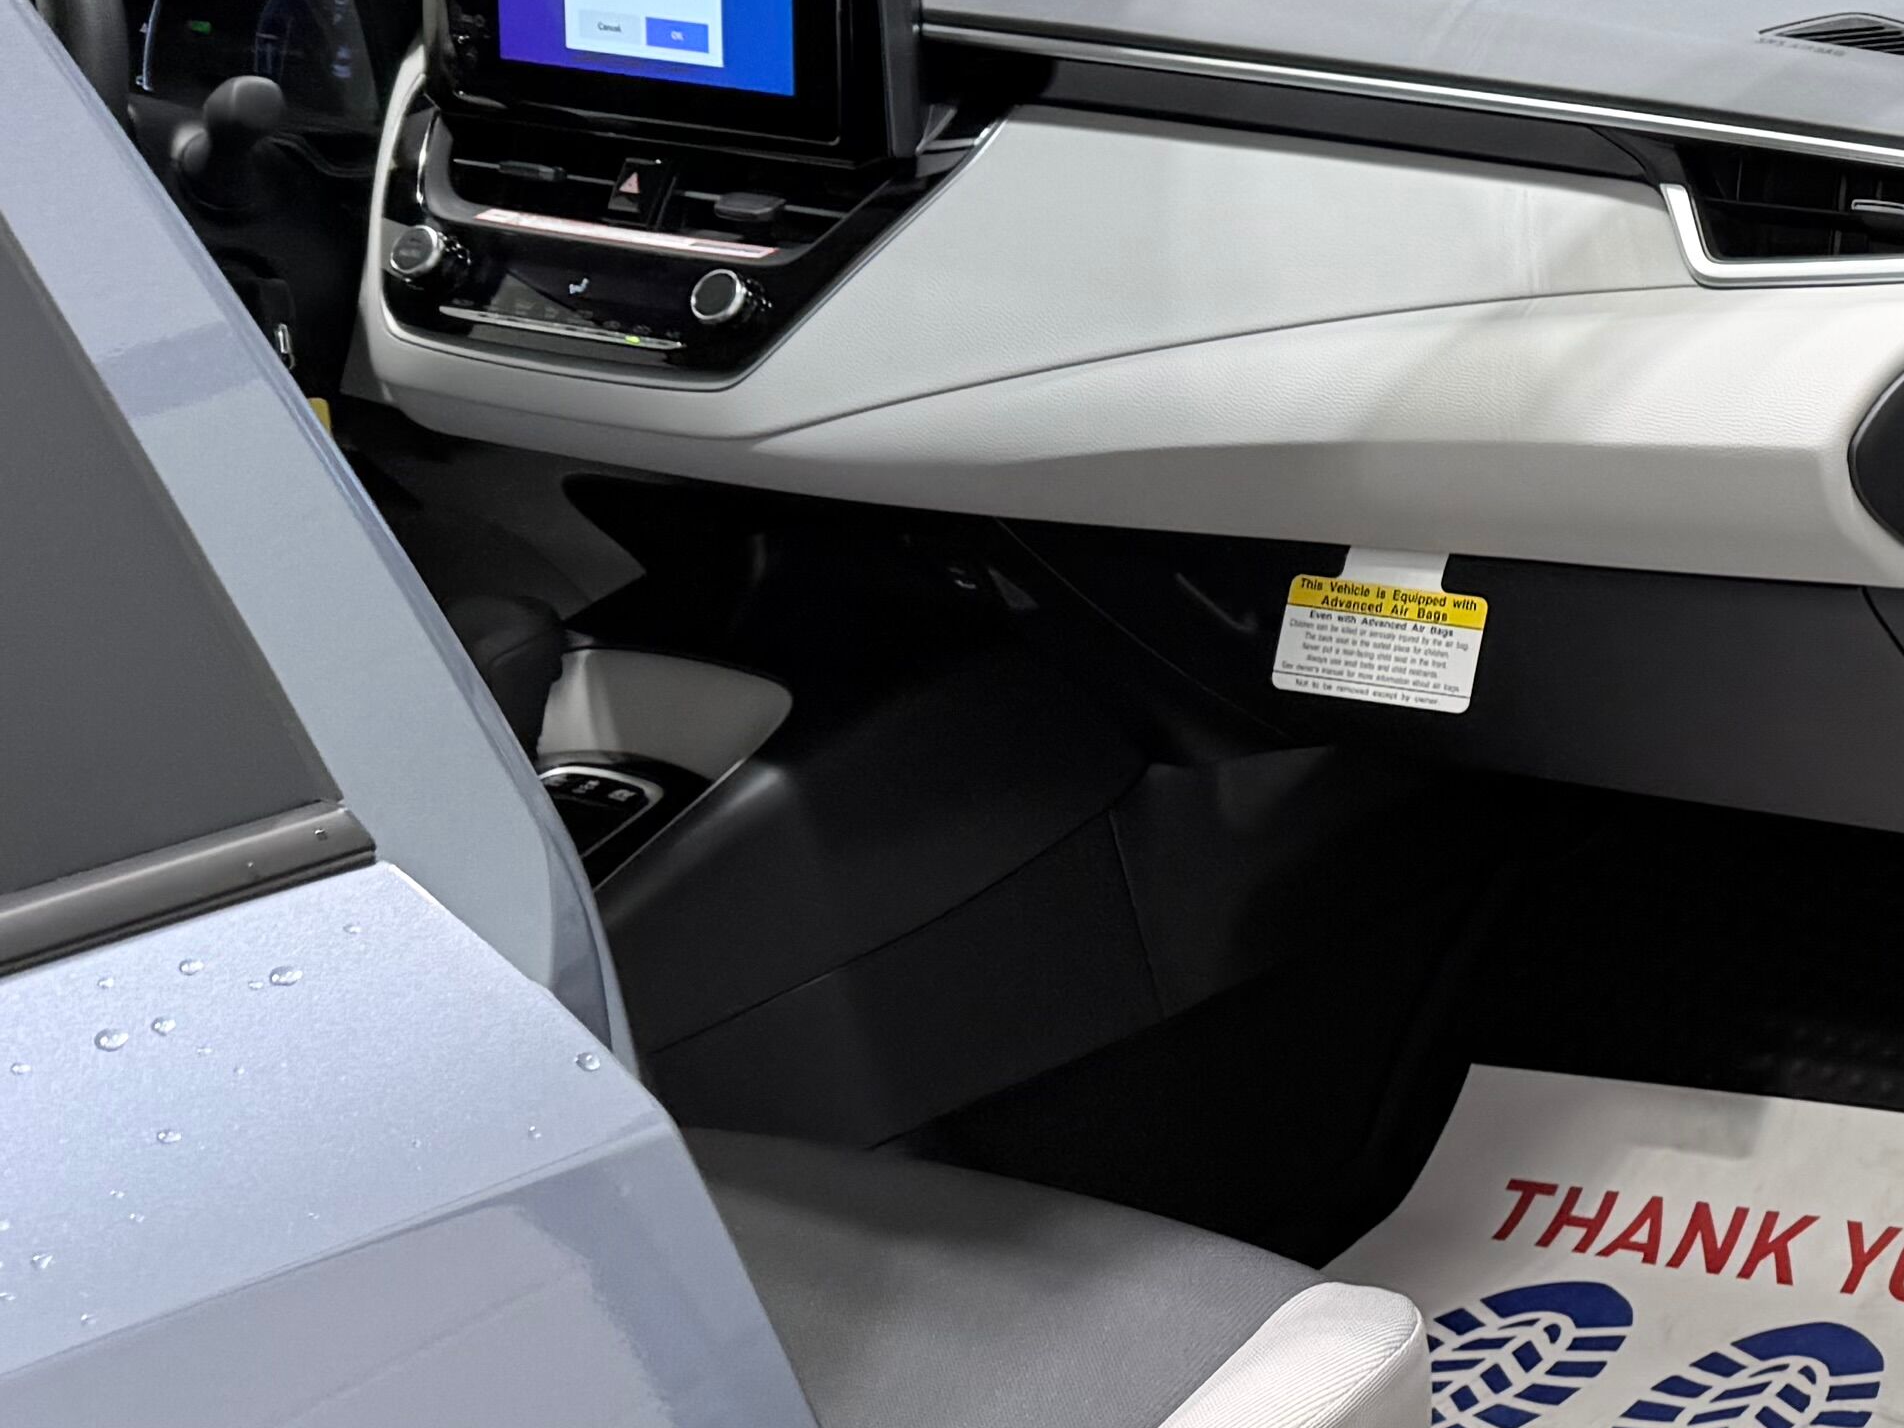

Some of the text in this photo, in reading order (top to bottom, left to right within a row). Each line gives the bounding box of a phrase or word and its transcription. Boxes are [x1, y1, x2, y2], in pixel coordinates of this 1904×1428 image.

[1300, 577, 1477, 612] This Vehicle is Equipped with
[1320, 595, 1448, 624] Advanced Air Bags
[1309, 609, 1454, 639] Even with Advanced Air Bags
[1491, 1178, 1821, 1287] THANK
